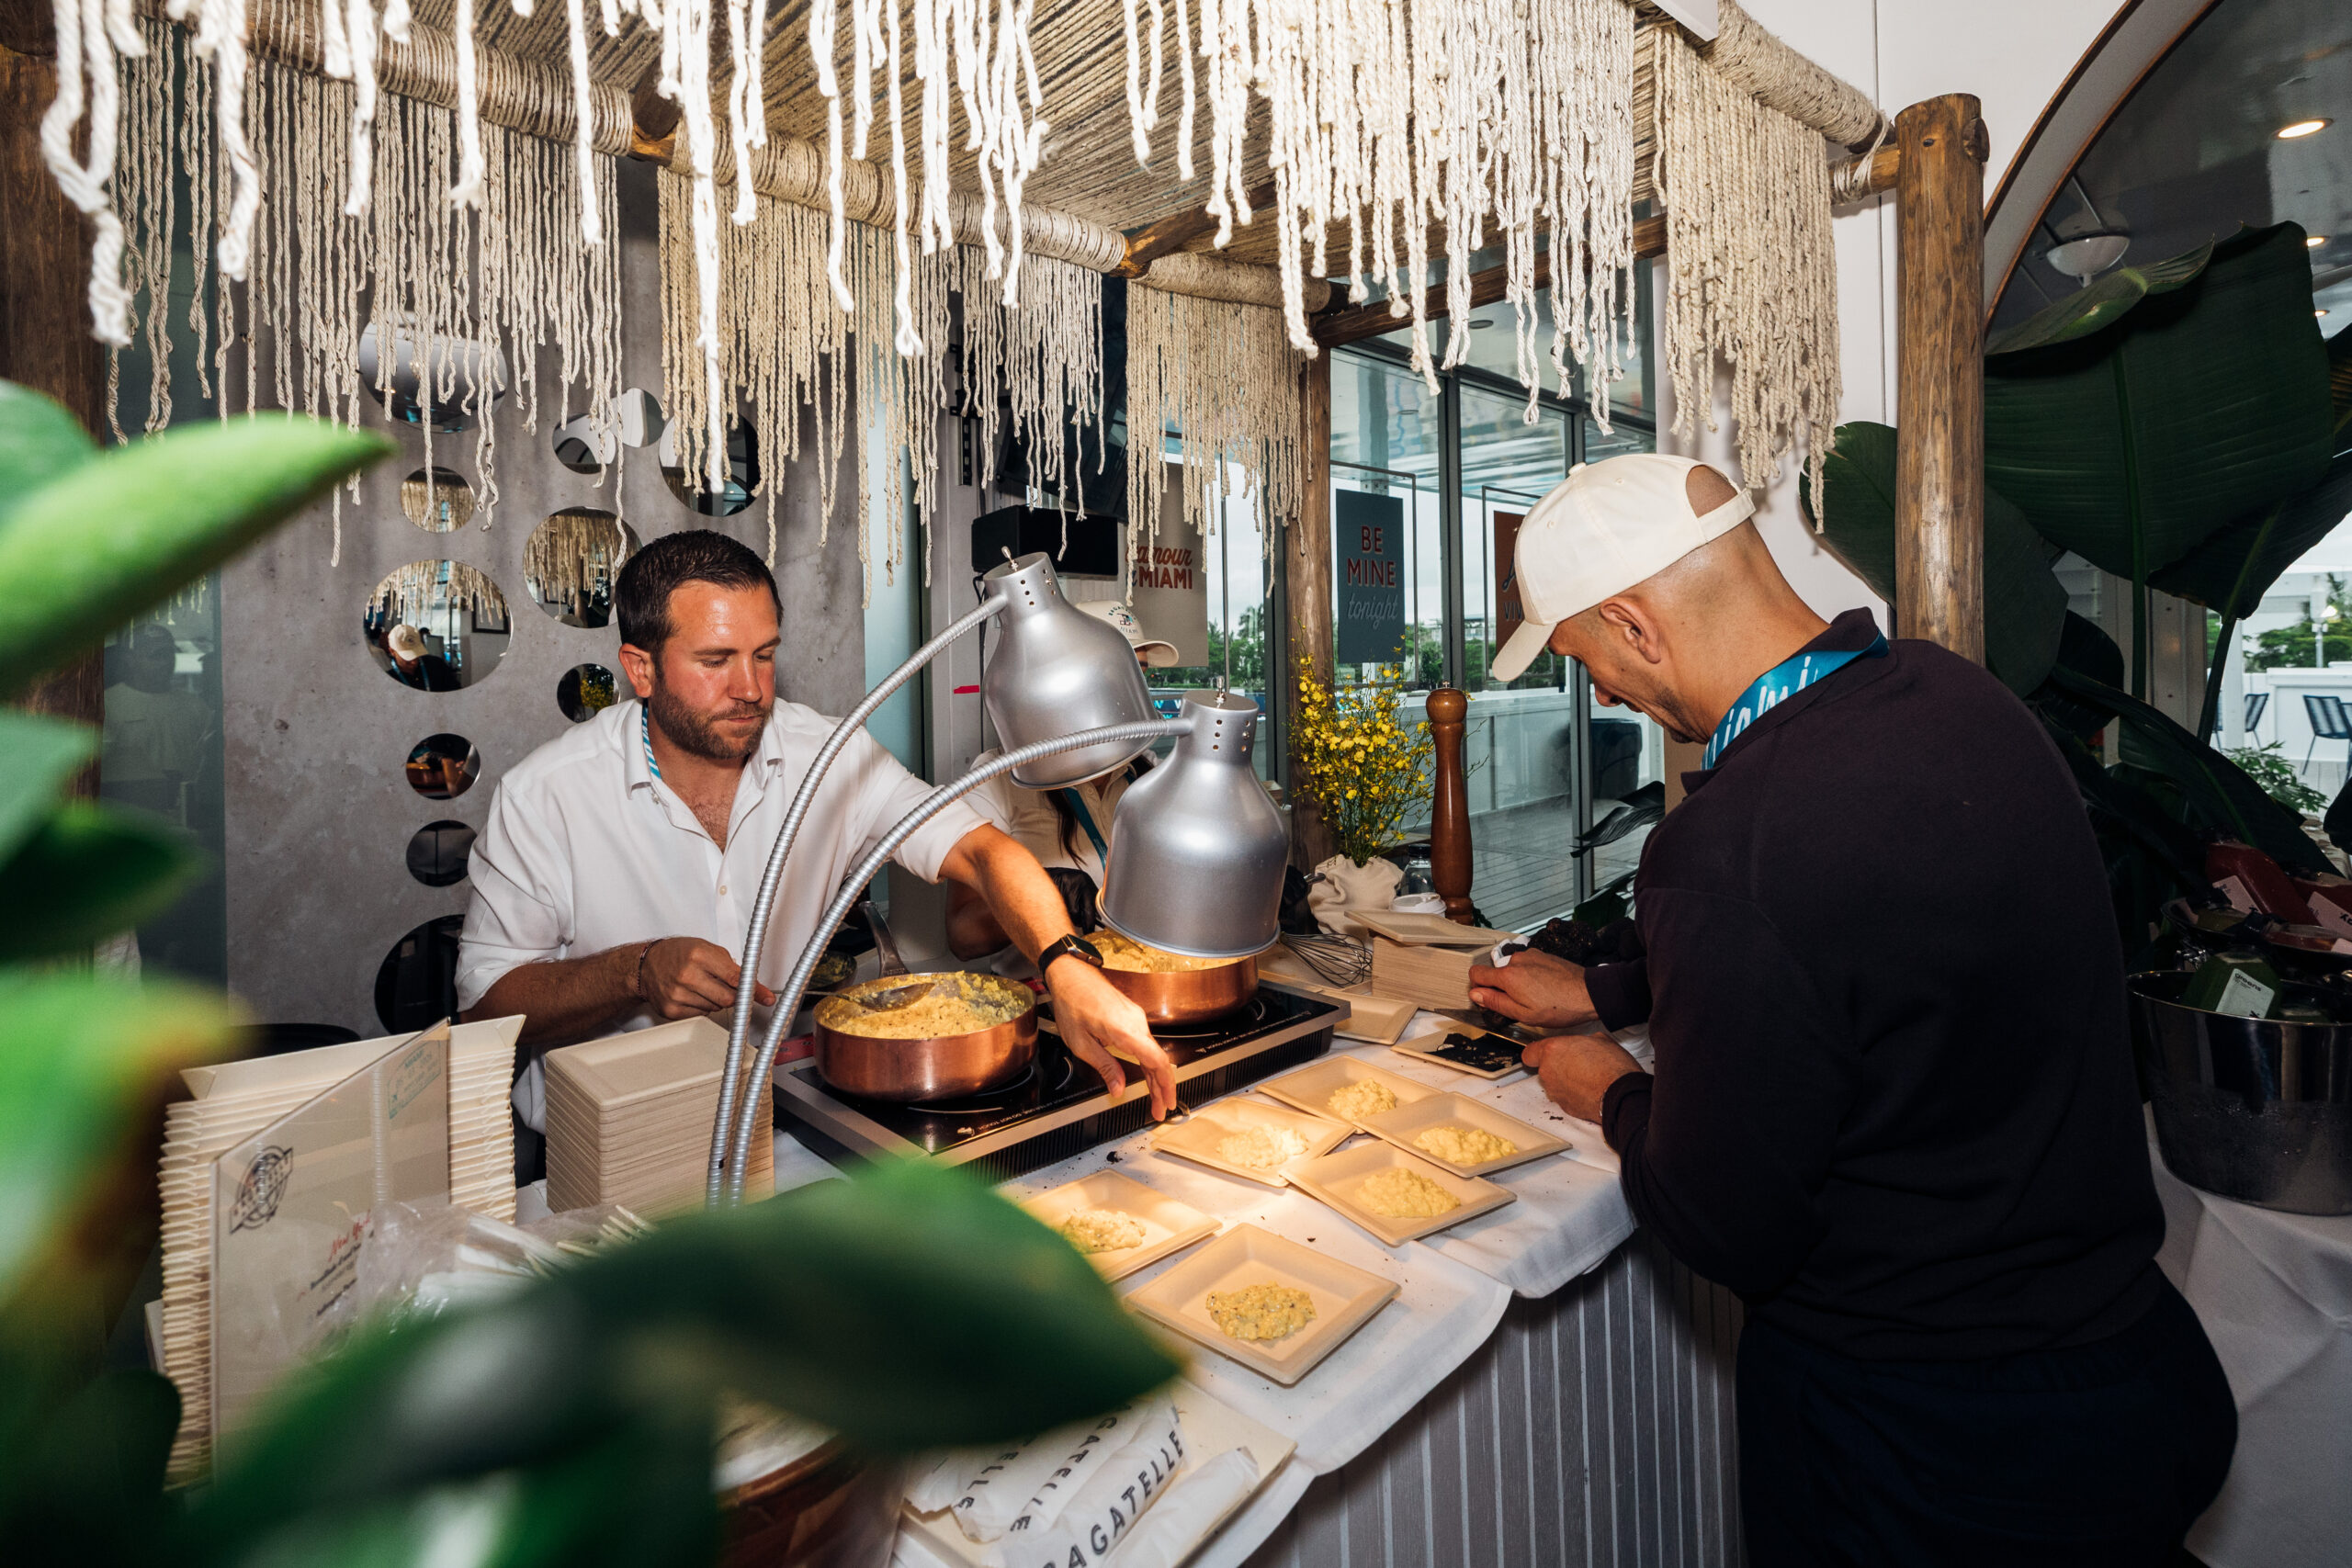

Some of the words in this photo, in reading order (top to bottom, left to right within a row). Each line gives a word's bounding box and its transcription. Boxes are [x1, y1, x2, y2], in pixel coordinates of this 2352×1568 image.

[1361, 525, 1383, 554] BE
[1139, 566, 1193, 590] MIAMI
[1347, 557, 1396, 588] MINE
[1347, 592, 1398, 630] tonight
